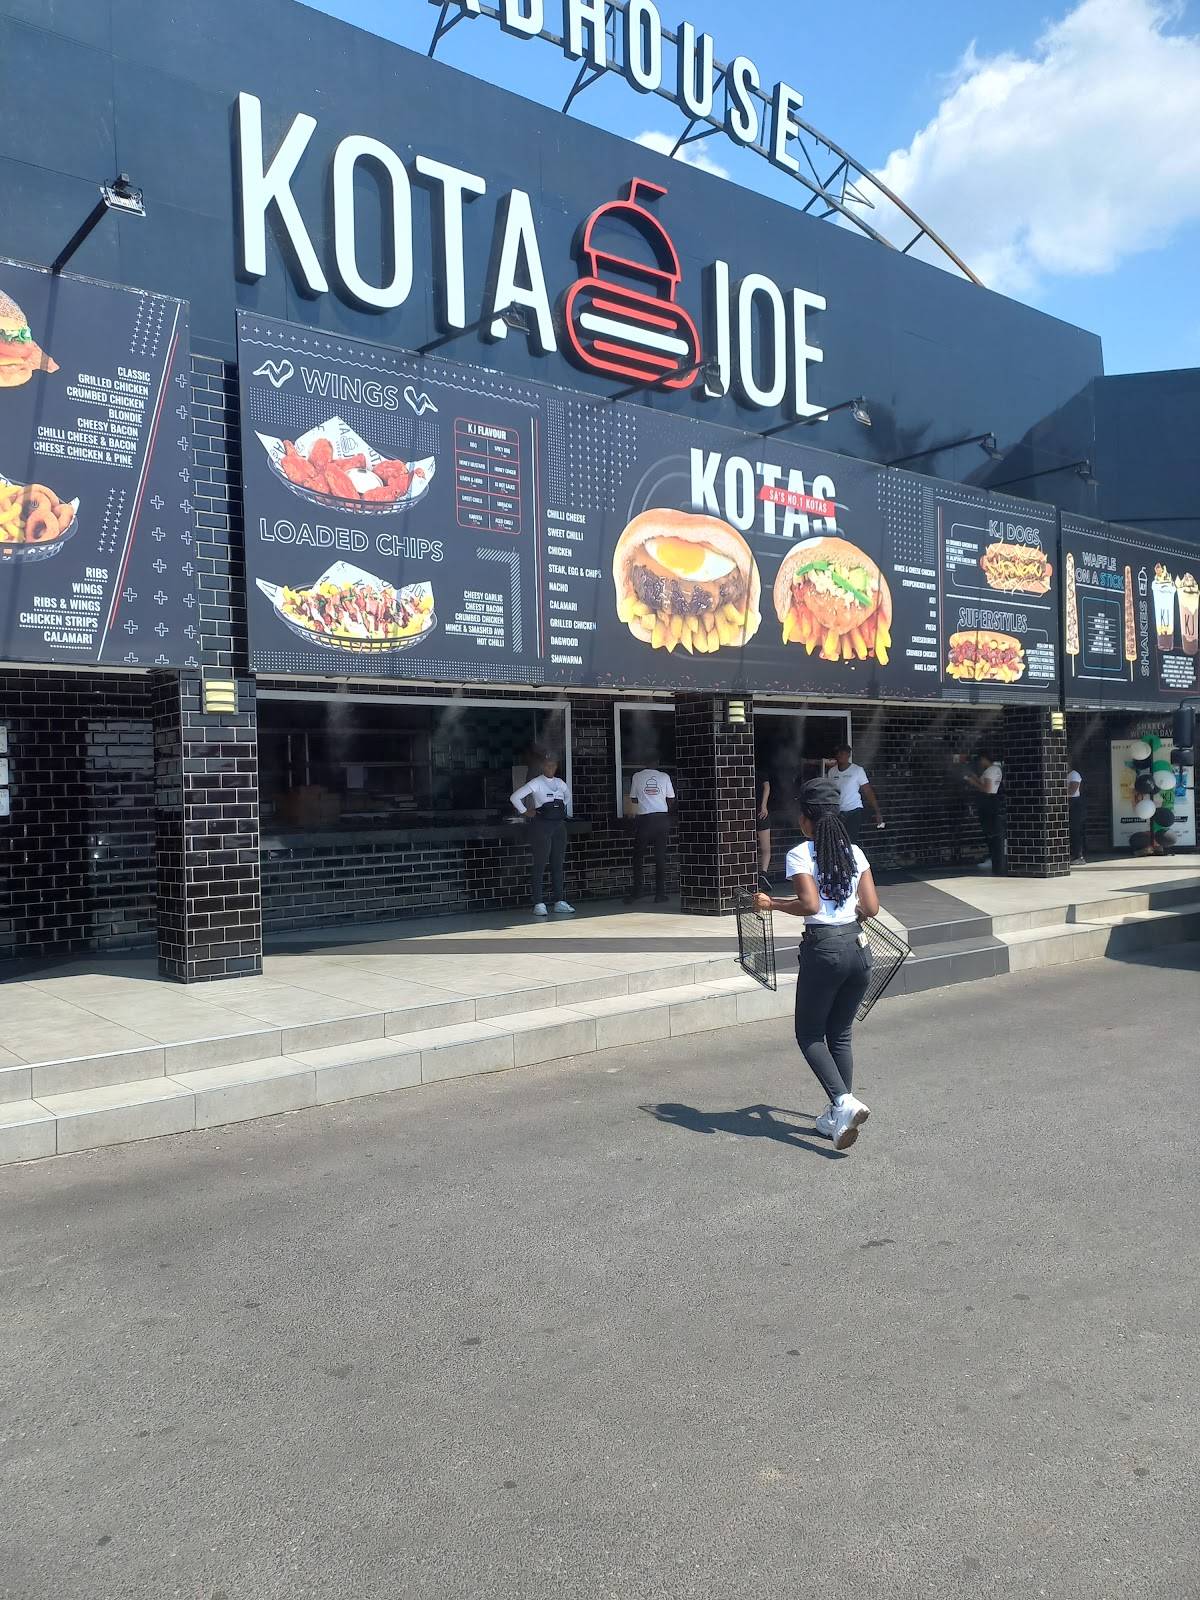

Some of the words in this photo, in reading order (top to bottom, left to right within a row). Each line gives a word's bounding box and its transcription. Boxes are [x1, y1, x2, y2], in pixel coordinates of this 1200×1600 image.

[428, 0, 803, 172] HOUSE
[236, 92, 557, 352] KOTA
[706, 260, 827, 421] JOE
[118, 367, 151, 381] CLASSIC
[78, 373, 112, 388] GRILLED
[114, 381, 149, 396] CHICKEN
[300, 367, 399, 411] WINGS
[66, 386, 108, 402] CRUMBED
[109, 395, 144, 409] CHICKEN
[108, 408, 143, 423] BLONDIE
[77, 417, 109, 432] CHEESY
[110, 423, 138, 437] BACON
[478, 426, 507, 440] FLAVOUR
[37, 426, 65, 439] CHILLI
[67, 431, 99, 445] CHEESE
[101, 436, 107, 446] &
[108, 438, 137, 451] BACON
[33, 441, 65, 454] CHEESE
[67, 446, 103, 460] CHICKEN
[106, 452, 112, 462] &
[114, 454, 133, 465] PINE
[691, 448, 837, 537] KOTAS
[769, 489, 785, 502] SA'S
[788, 496, 803, 508] NO.1
[806, 499, 828, 513] KOTAS
[547, 509, 565, 521] CHILLI
[565, 512, 586, 524] CHEESE
[260, 518, 369, 551] LOADED
[376, 533, 444, 562] CHIPS
[547, 527, 565, 538] SWEET
[566, 530, 584, 541] CHILLI
[989, 520, 1004, 538] KJ
[1006, 523, 1040, 545] DOGS
[547, 545, 572, 557] CHICKEN
[1082, 552, 1116, 571] WAFFLE
[86, 567, 108, 579] RIBS
[548, 564, 567, 575] STEAK,
[568, 566, 579, 576] EGG
[580, 568, 584, 577] &
[585, 568, 602, 579] CHIPS
[1076, 567, 1091, 583] ON
[1092, 570, 1099, 585] A
[1100, 572, 1124, 590] STICK
[72, 582, 103, 595] WINGS
[549, 582, 569, 593] NACHO
[33, 596, 57, 608] RIBS
[59, 599, 67, 609] &
[70, 599, 101, 612] WINGS
[464, 590, 484, 599] CHEESY
[484, 593, 503, 602] GARLIC
[465, 602, 485, 611] CHEESY
[486, 605, 503, 613] BACON
[549, 600, 578, 612] CALAMARI
[20, 612, 62, 626] CHICKEN
[65, 616, 98, 628] STRIPS
[550, 618, 572, 629] GRILLED
[573, 620, 597, 630] CHICKEN
[959, 607, 1027, 633] SUPERSTYLES
[1185, 613, 1195, 635] KJ
[44, 631, 93, 644] CALAMARI
[476, 638, 487, 646] HOT
[488, 638, 505, 647] CHILLI
[551, 636, 579, 647] DAGWOOD
[1140, 600, 1150, 677] SHAKES
[551, 654, 583, 665] SHAWARMA
